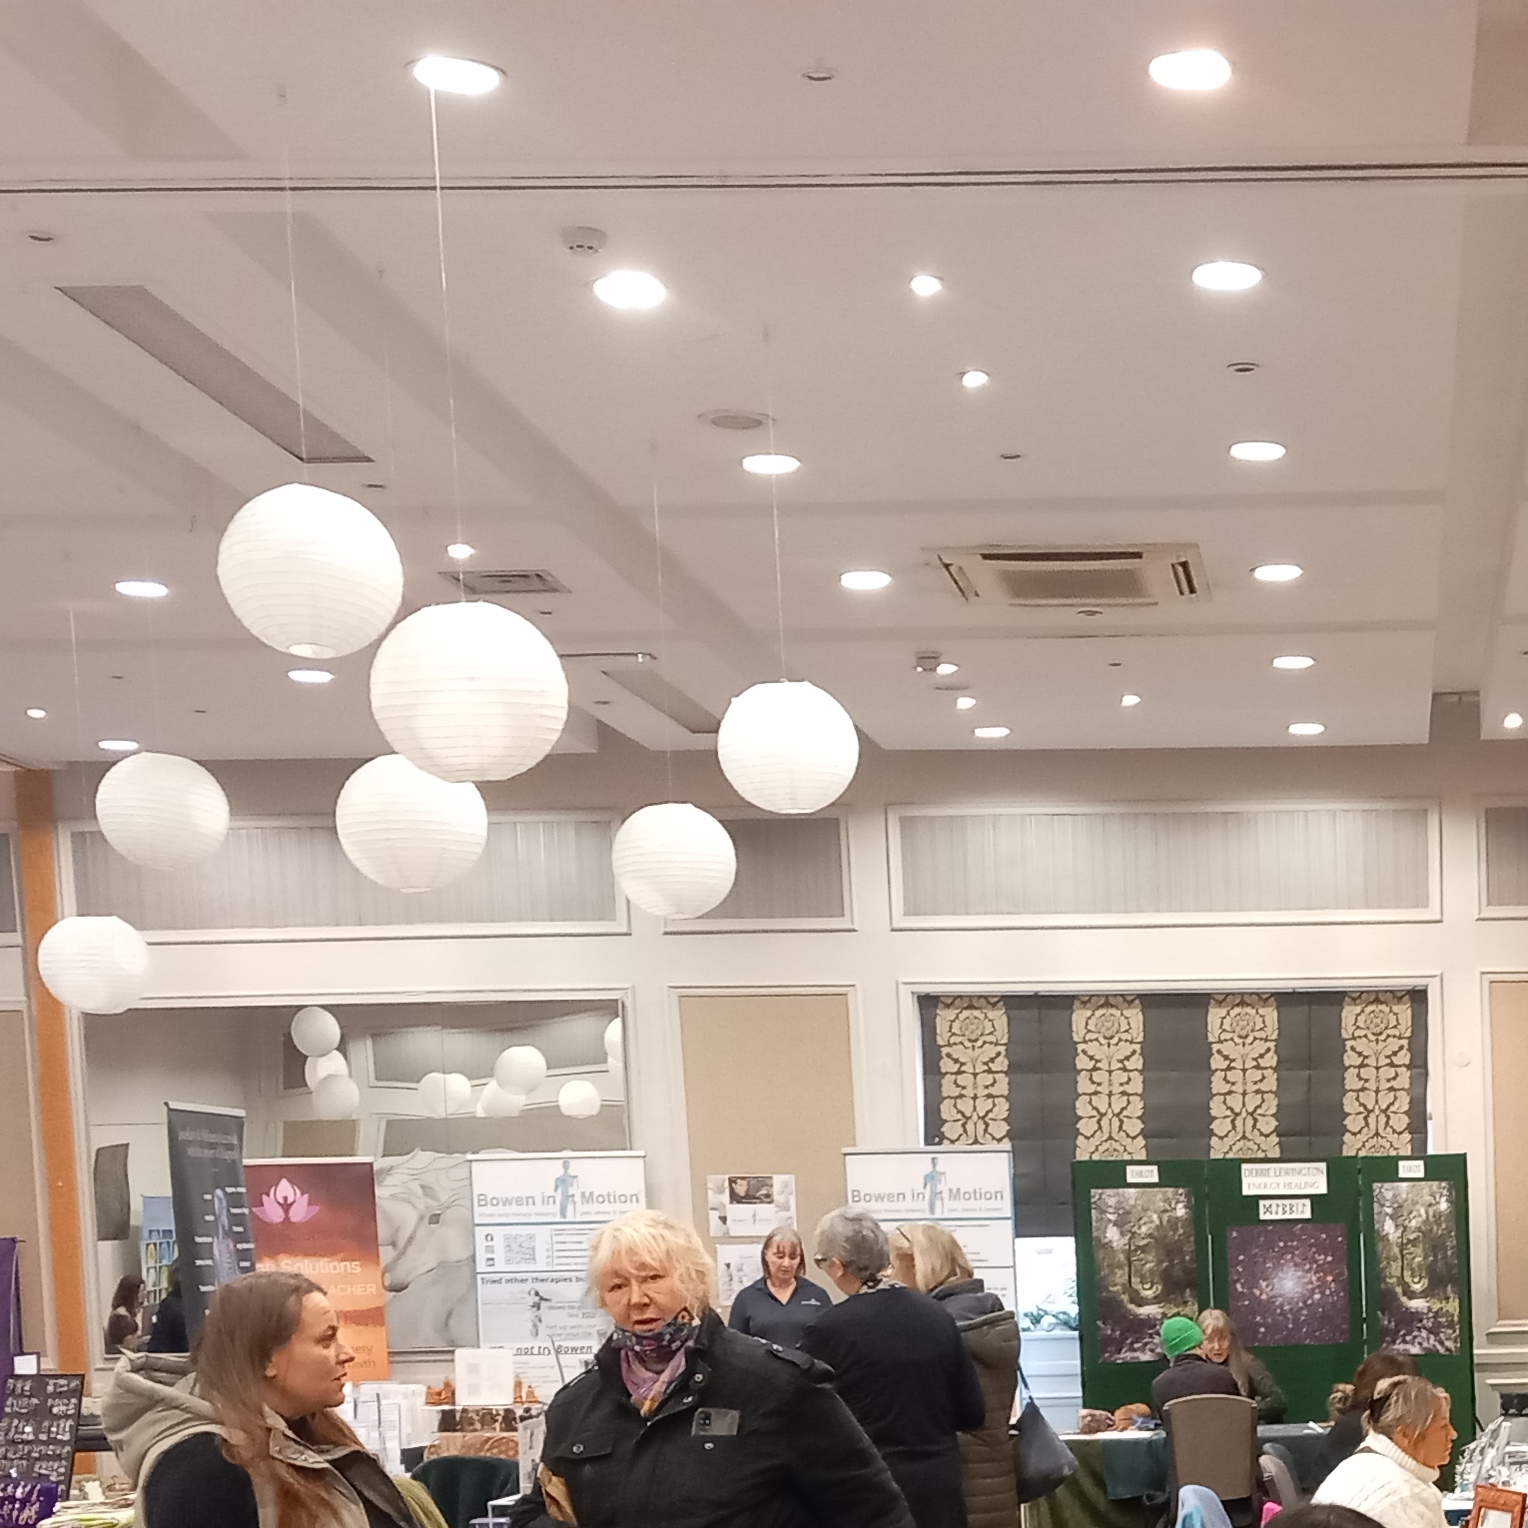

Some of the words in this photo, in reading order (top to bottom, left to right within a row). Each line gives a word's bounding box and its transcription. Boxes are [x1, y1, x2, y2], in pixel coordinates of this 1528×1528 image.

[1243, 1166, 1272, 1179] DEBBIE
[1247, 1180, 1280, 1191] ENERGY
[1282, 1179, 1320, 1190] HEALING
[476, 1193, 536, 1208] Bowen
[541, 1193, 557, 1206] in
[580, 1190, 640, 1205] Motion
[851, 1189, 906, 1204] Bowen
[911, 1188, 926, 1202] in
[948, 1186, 1004, 1201] Motion
[481, 1277, 502, 1285] Tried
[505, 1277, 529, 1285] other
[531, 1276, 573, 1285] therapies
[328, 1284, 376, 1295] ACHER
[556, 1344, 593, 1354] Bowen
